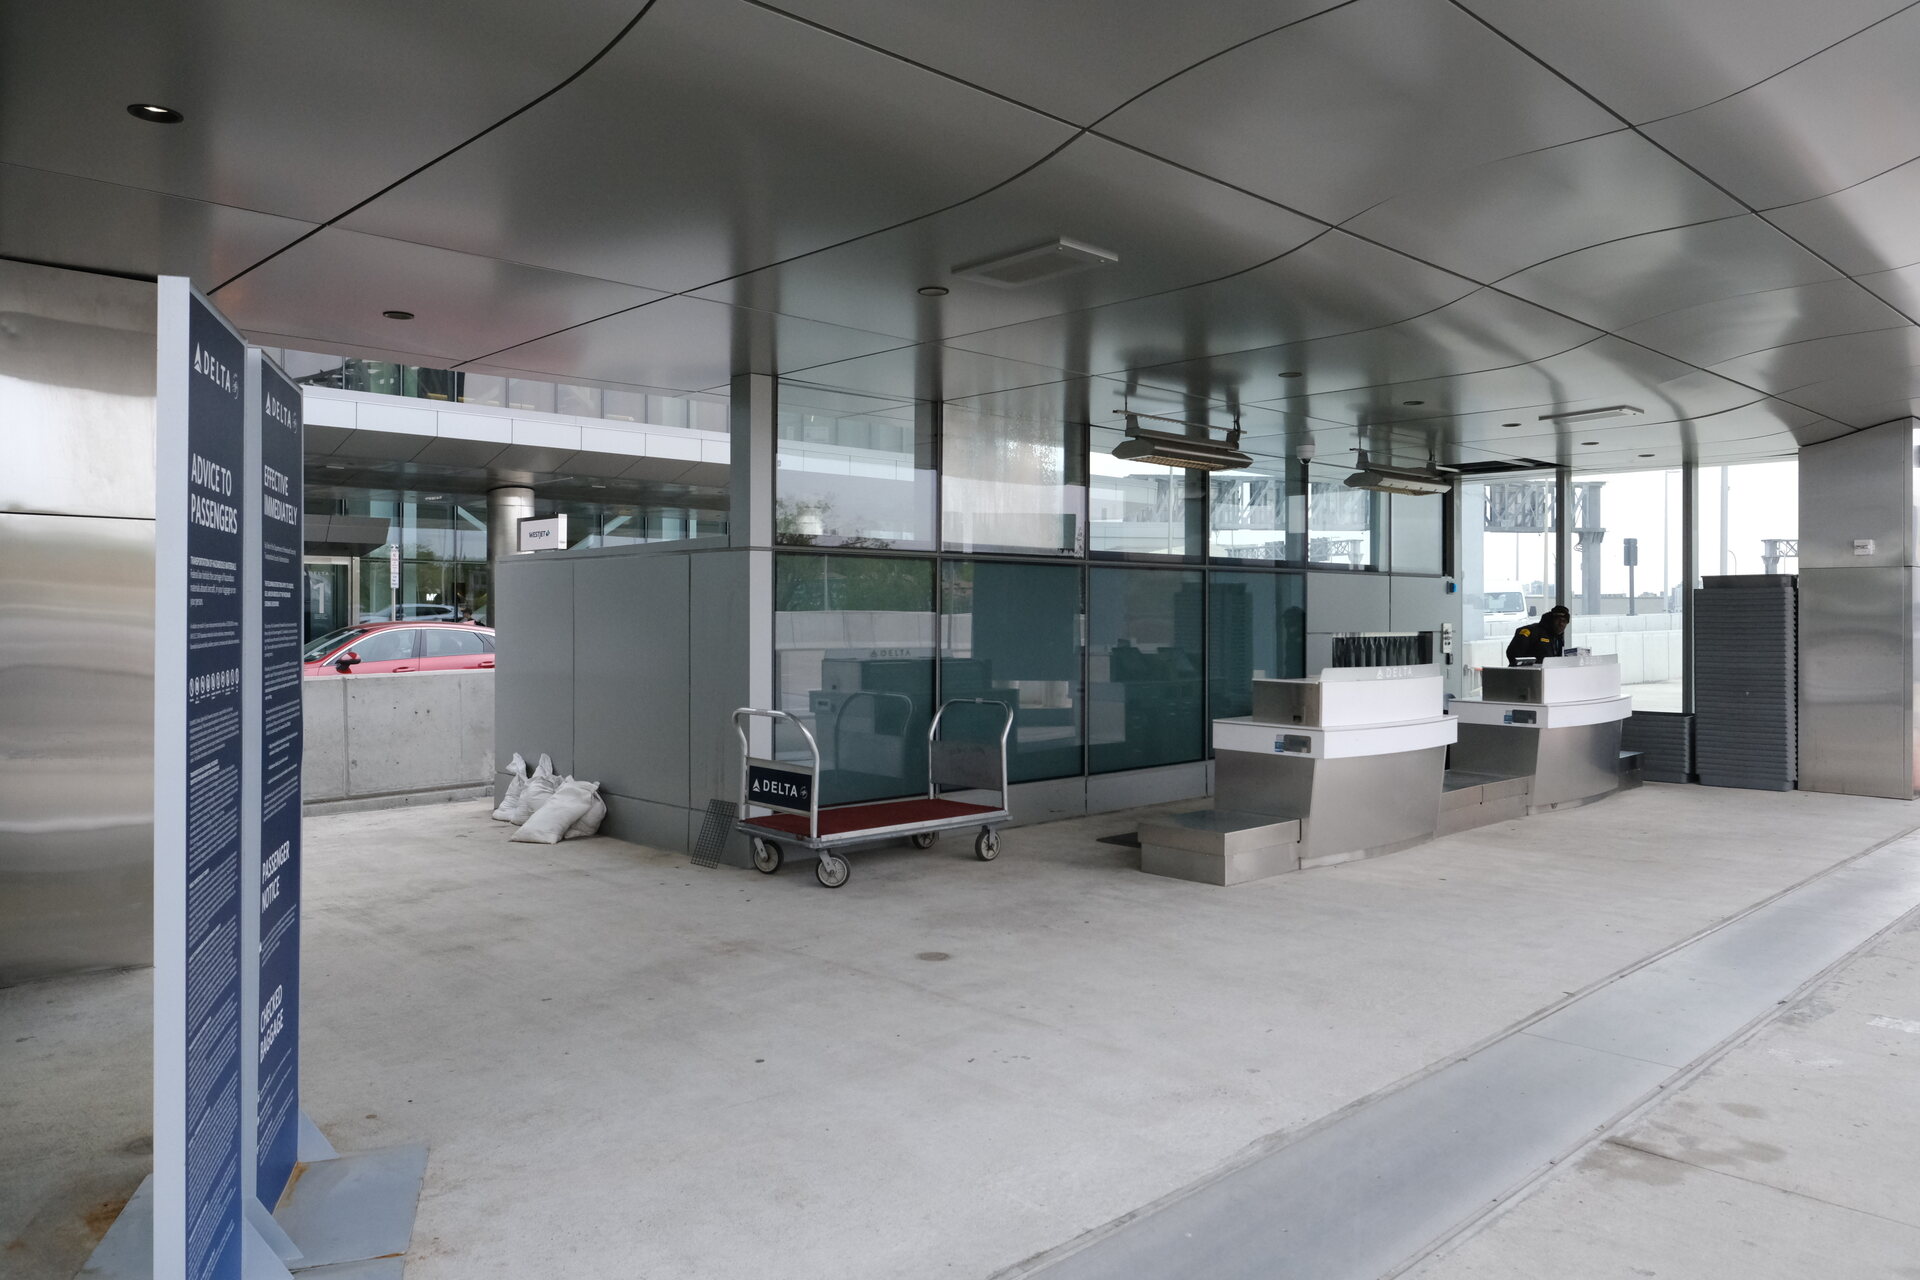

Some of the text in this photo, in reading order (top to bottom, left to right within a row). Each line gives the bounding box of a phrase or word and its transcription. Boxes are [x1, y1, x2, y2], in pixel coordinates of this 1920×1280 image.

[203, 350, 231, 393] DELTA
[271, 397, 292, 428] DELTA
[191, 453, 232, 497] ADVICE TO
[264, 465, 289, 497] EFFECTIVE
[191, 493, 238, 535] PASSENGERS
[264, 497, 298, 526] IMMEDIATELY
[313, 582, 325, 613] 1
[1385, 666, 1414, 678] DELTA
[763, 779, 798, 798] DELTA
[262, 840, 290, 884] PASSENGER
[261, 875, 280, 913] NOTICE
[260, 983, 283, 1034] CHECKED
[260, 1008, 284, 1064] BAGGAGE
